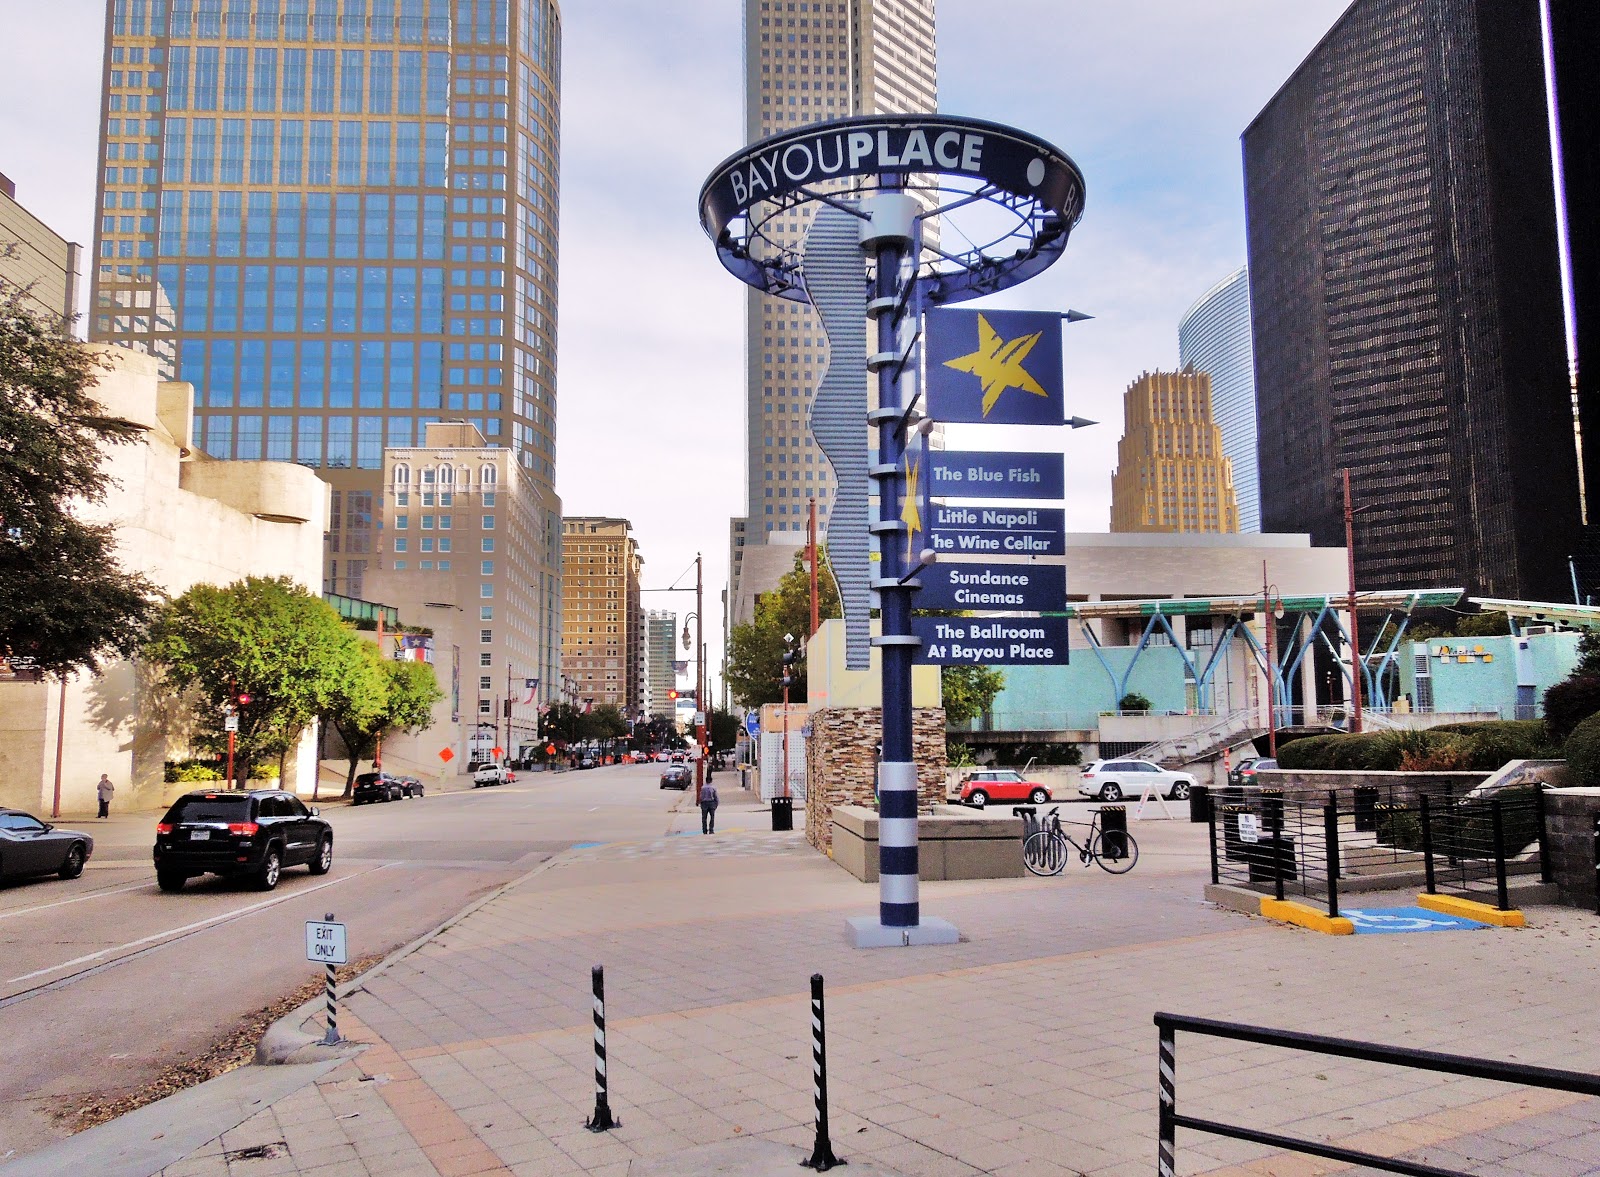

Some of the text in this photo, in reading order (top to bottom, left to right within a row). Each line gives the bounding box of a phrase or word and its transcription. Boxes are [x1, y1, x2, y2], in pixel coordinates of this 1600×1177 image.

[933, 466, 1041, 482] The Blue Fish
[938, 510, 1037, 528] Little Napoli
[958, 535, 1000, 550] Wine
[1004, 536, 1051, 550] Cellar
[950, 570, 1029, 586] Sundance
[954, 589, 1024, 604] Cinemas
[935, 624, 1045, 639] The Ballroom
[927, 644, 1054, 661] At Bayou Place
[316, 928, 333, 940] EXIT
[315, 944, 335, 956] ONLY
